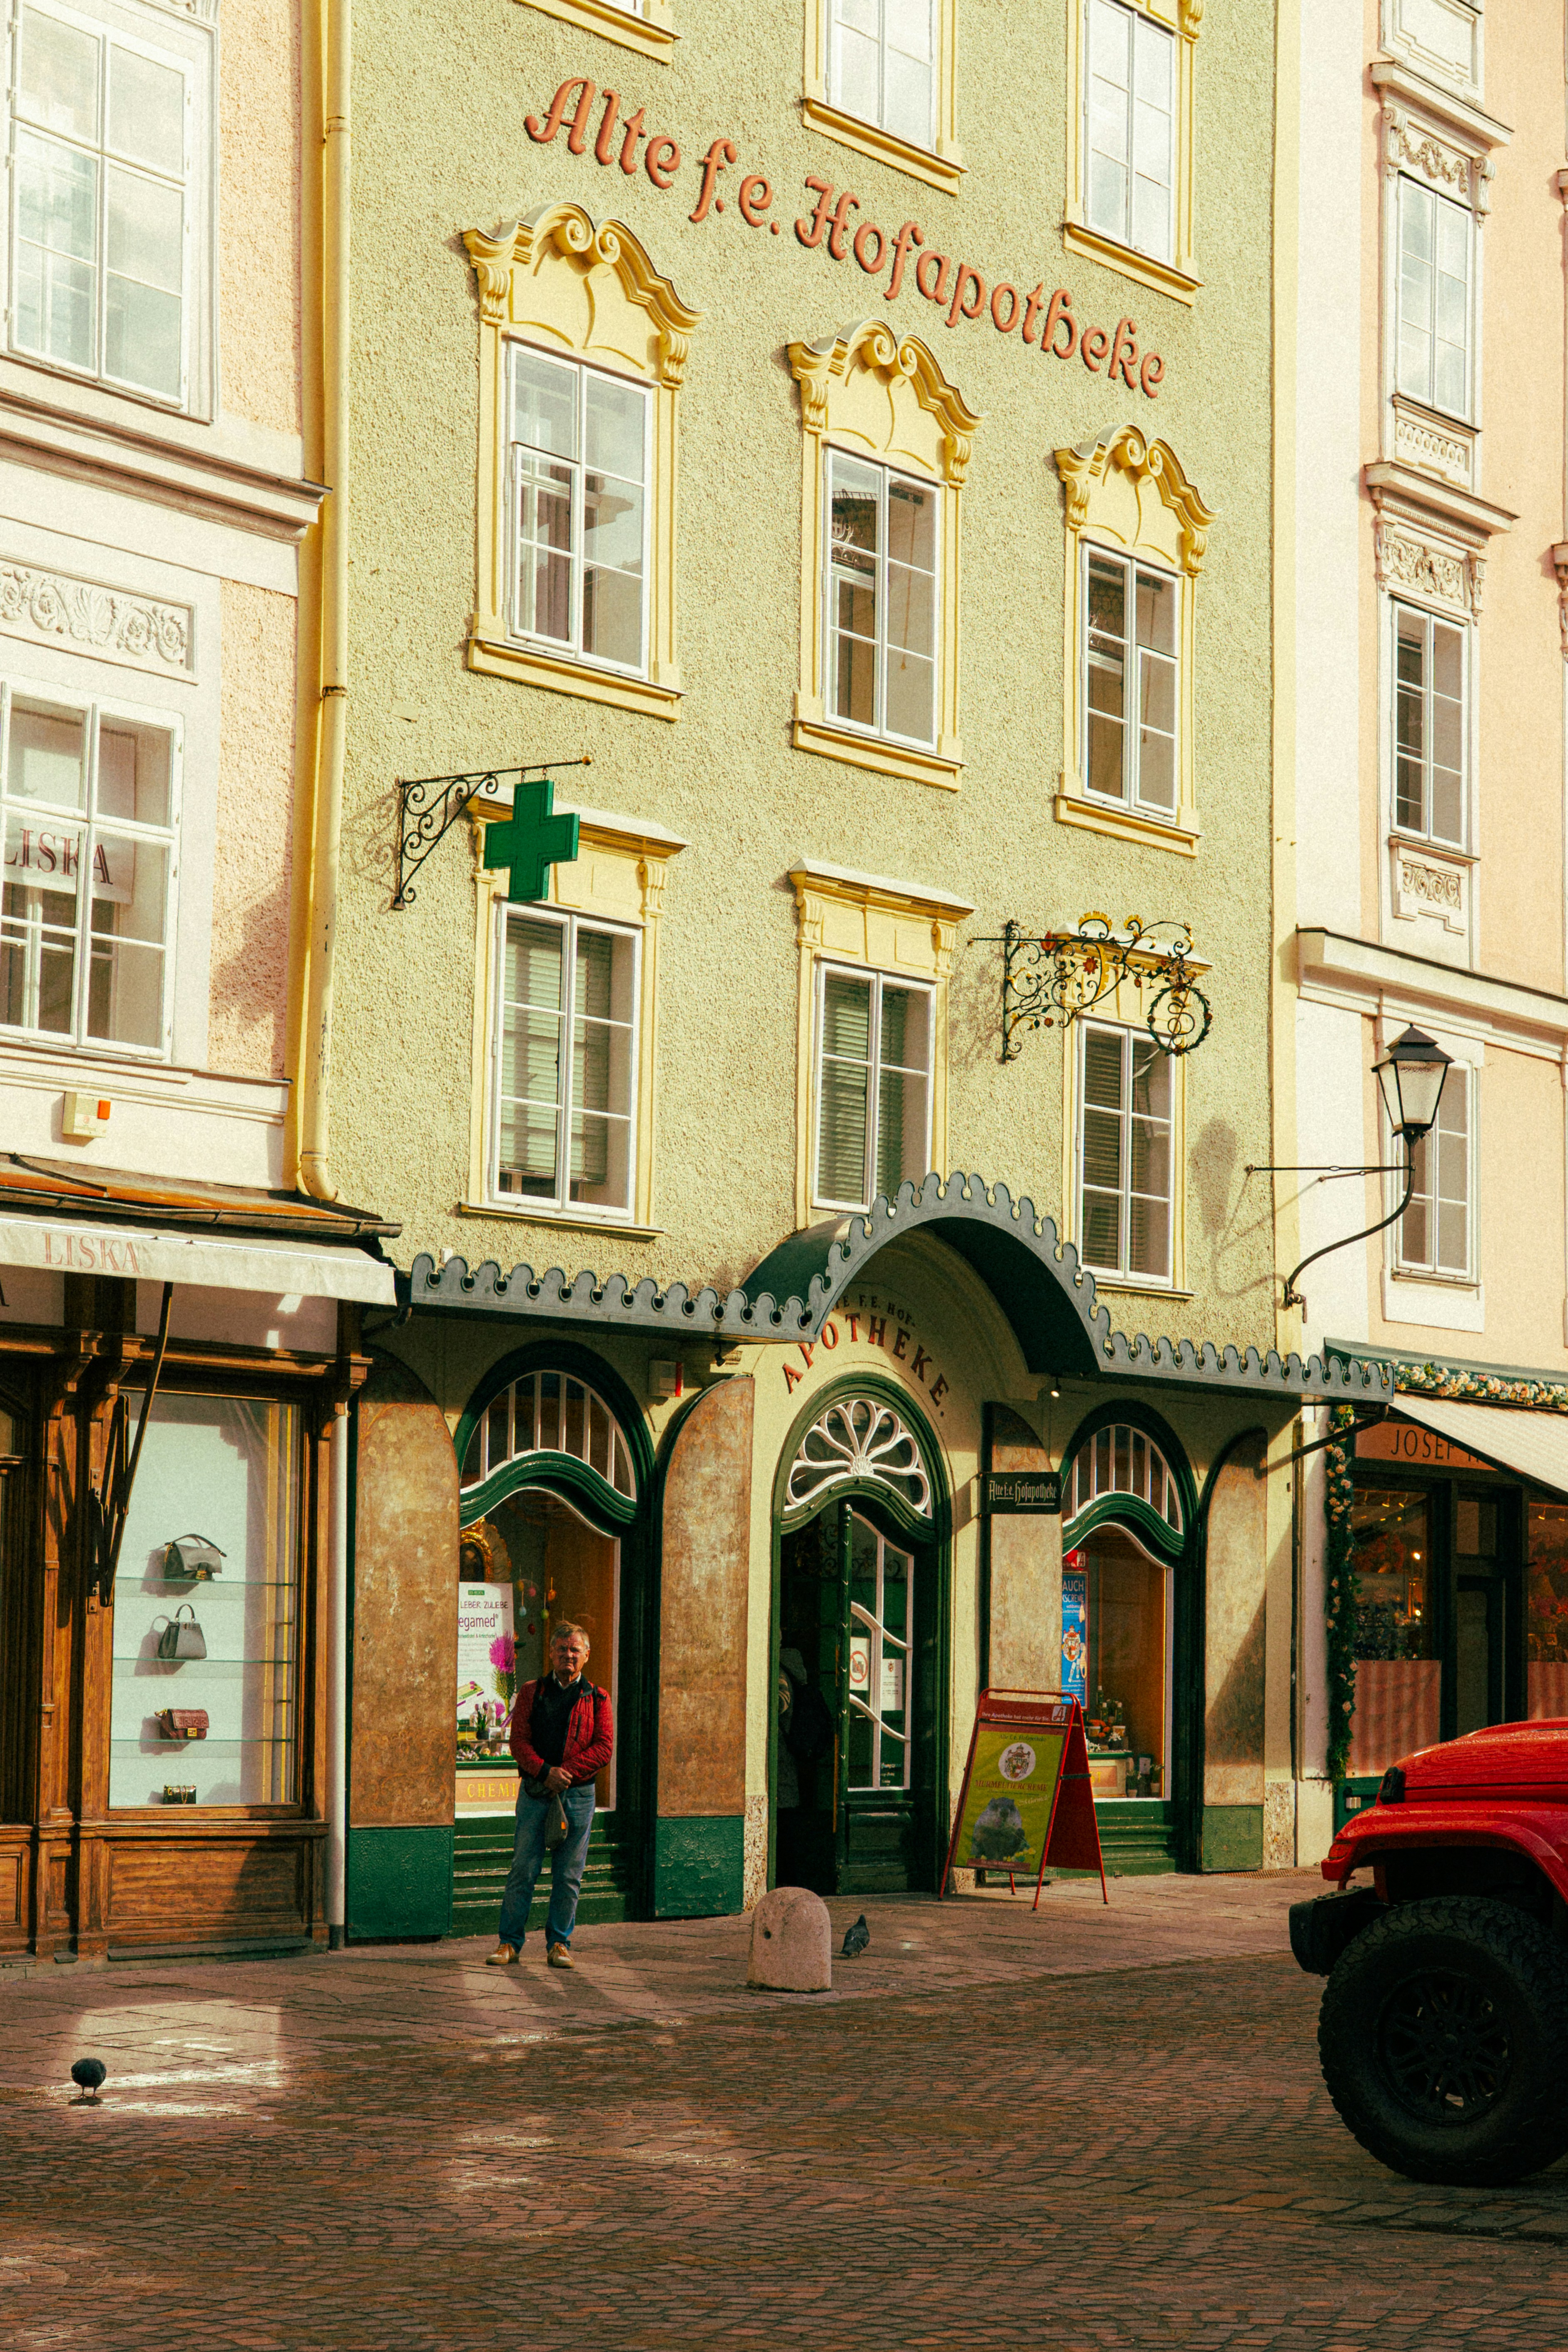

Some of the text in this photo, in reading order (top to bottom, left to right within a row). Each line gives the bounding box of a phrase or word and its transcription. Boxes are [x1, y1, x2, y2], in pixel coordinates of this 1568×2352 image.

[524, 76, 682, 190] Alte
[794, 175, 1166, 399] Hofapotheke
[42, 1232, 142, 1273] LISKA
[1062, 1580, 1084, 1591] AUCH
[467, 1783, 516, 1798] CHEMI
